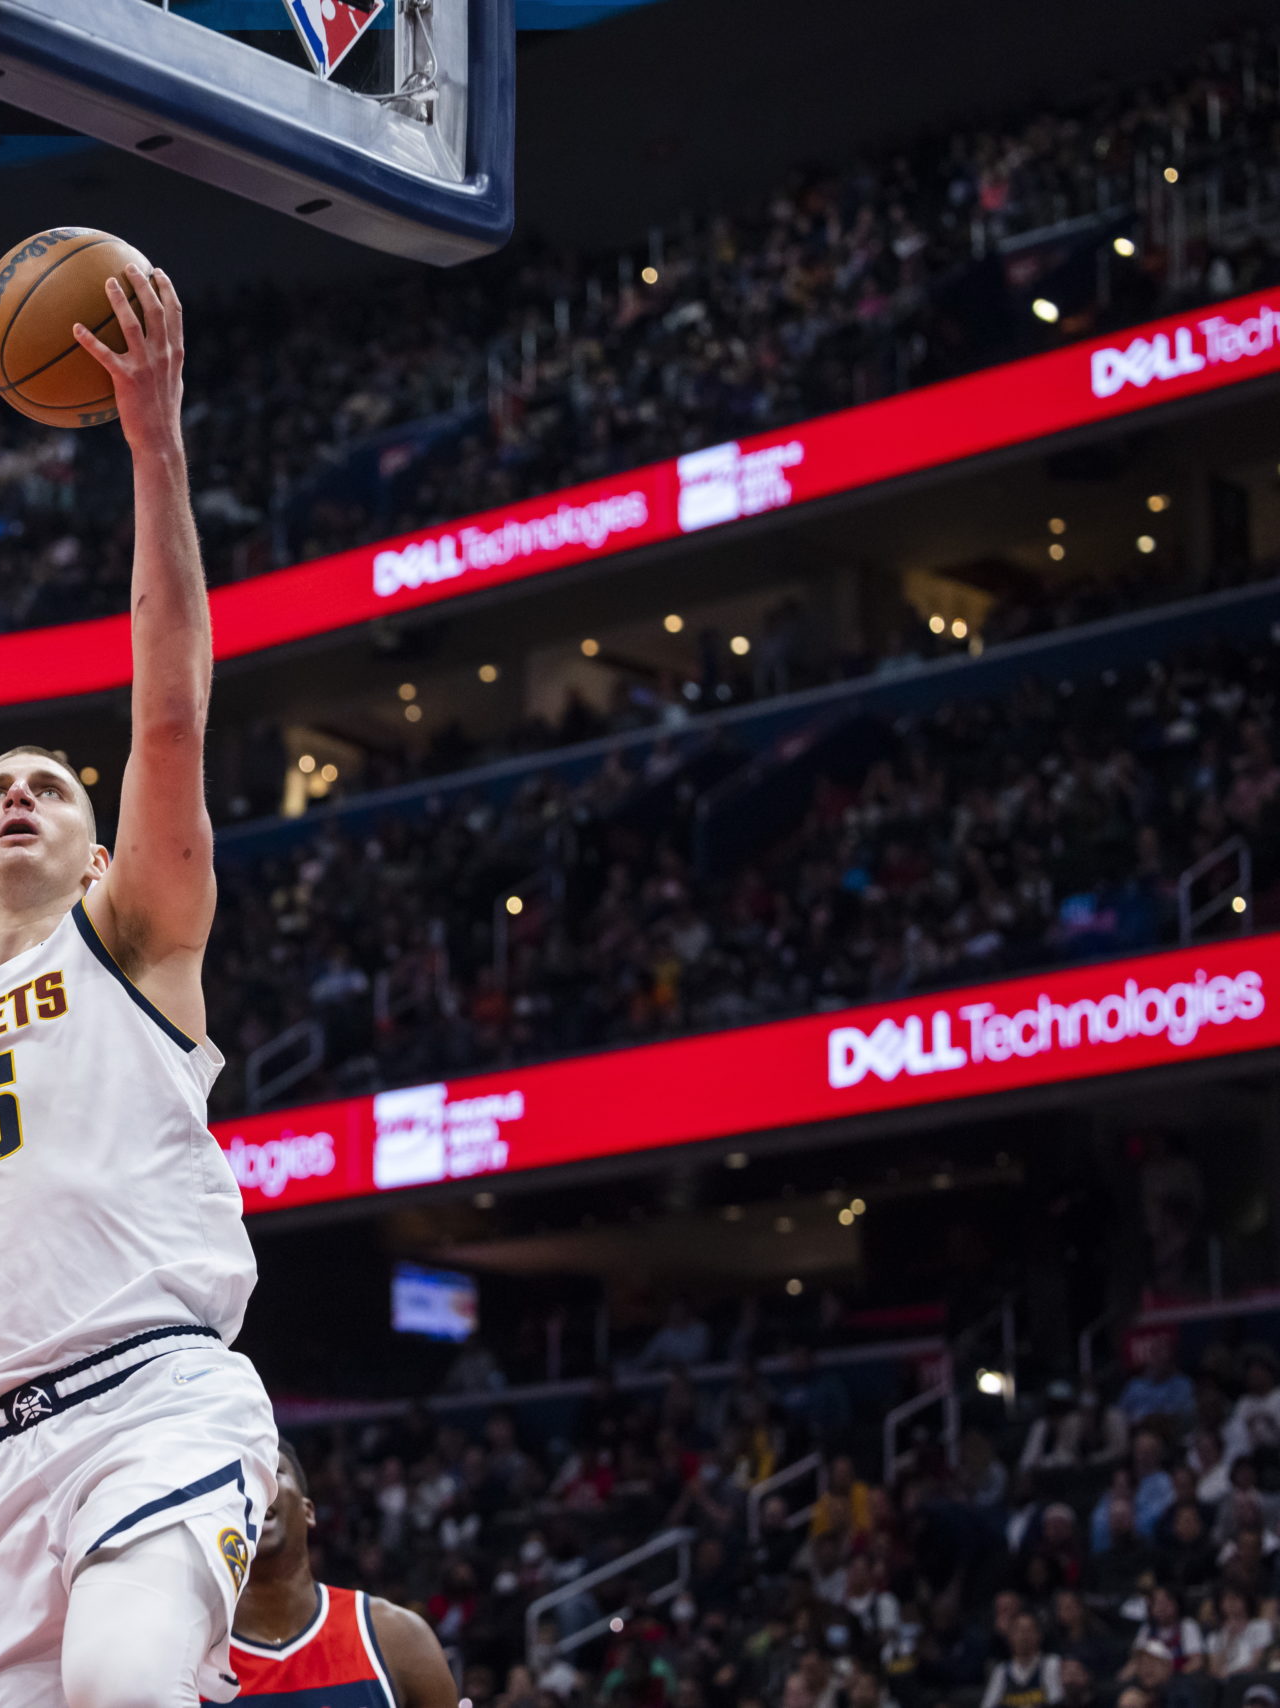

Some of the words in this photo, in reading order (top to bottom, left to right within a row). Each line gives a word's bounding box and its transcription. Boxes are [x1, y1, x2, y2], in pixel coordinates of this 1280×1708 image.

[1091, 326, 1207, 399] DELL
[373, 534, 463, 597] DELL
[828, 1010, 968, 1089] DELL
[959, 968, 1265, 1065] Technologies
